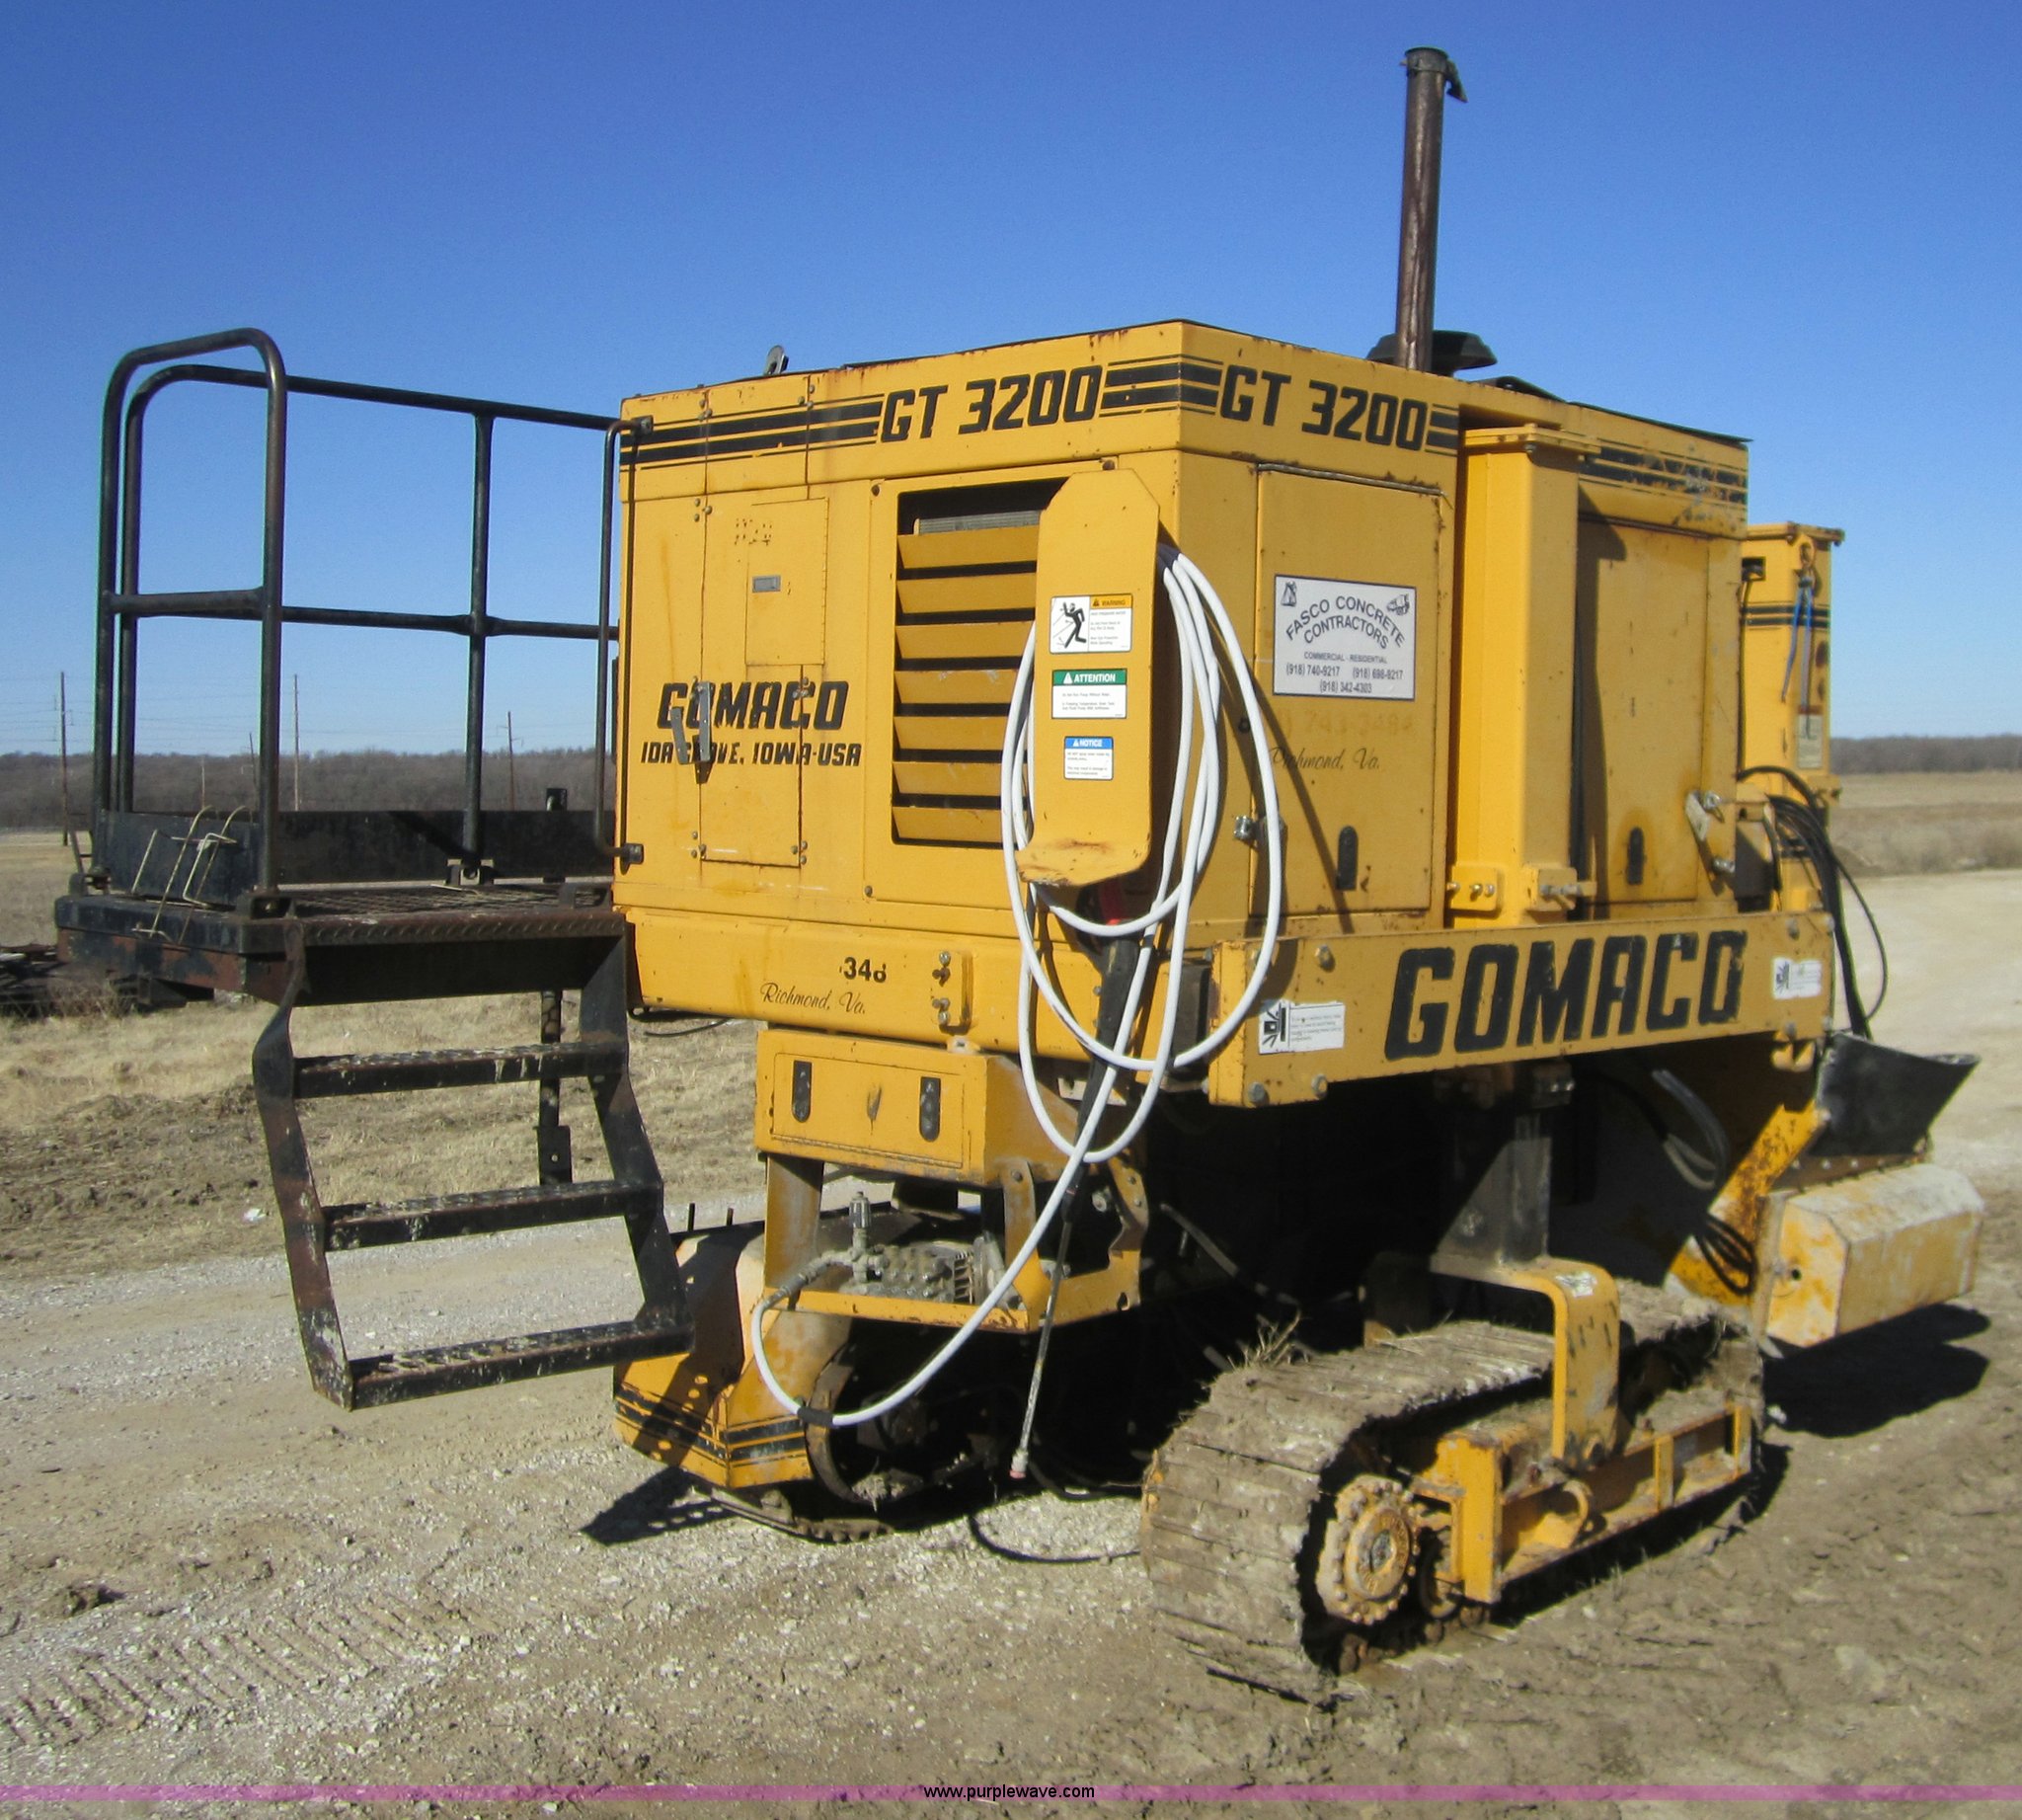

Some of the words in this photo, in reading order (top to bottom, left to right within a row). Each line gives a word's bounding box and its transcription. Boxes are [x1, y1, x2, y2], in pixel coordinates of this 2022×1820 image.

[881, 384, 949, 443] GT
[958, 364, 1103, 435] 3200
[1219, 363, 1291, 427] GT
[1301, 378, 1429, 451] 3200
[1285, 598, 1330, 641] FASCO
[1335, 595, 1405, 648] CONCRETE
[1303, 614, 1389, 650] CONTRACTORS
[1285, 663, 1305, 676] (918)
[1303, 651, 1345, 662] COMMERCIAL
[1350, 654, 1388, 664] RESIDENTIAL
[1073, 673, 1117, 683] ATTENTION
[657, 680, 849, 731] GOMACO
[641, 742, 673, 764] IDA
[1079, 739, 1103, 748] NOTICE
[759, 982, 831, 1011] Richmond,
[839, 990, 866, 1015] Va.
[1384, 930, 1749, 1062] GOMACO
